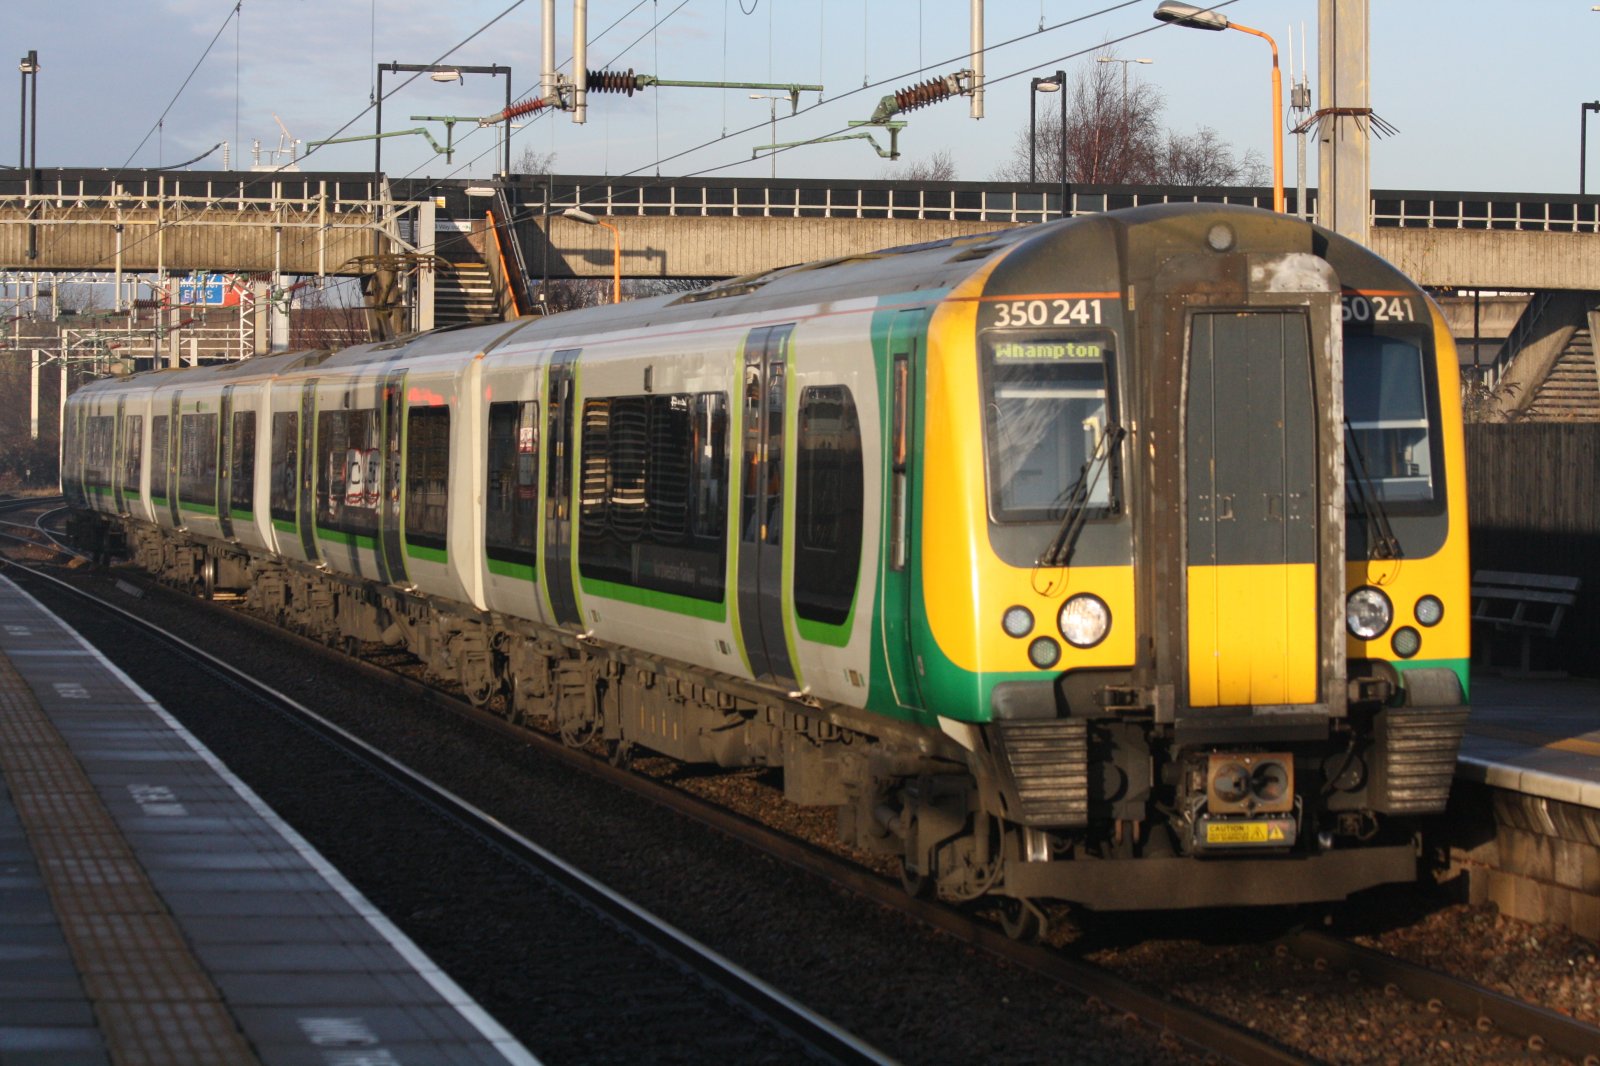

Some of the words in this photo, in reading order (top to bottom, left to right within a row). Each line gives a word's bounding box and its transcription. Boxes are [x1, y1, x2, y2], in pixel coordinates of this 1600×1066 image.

[994, 300, 1048, 327] 350
[1052, 299, 1102, 325] 241
[1371, 296, 1414, 321] 241
